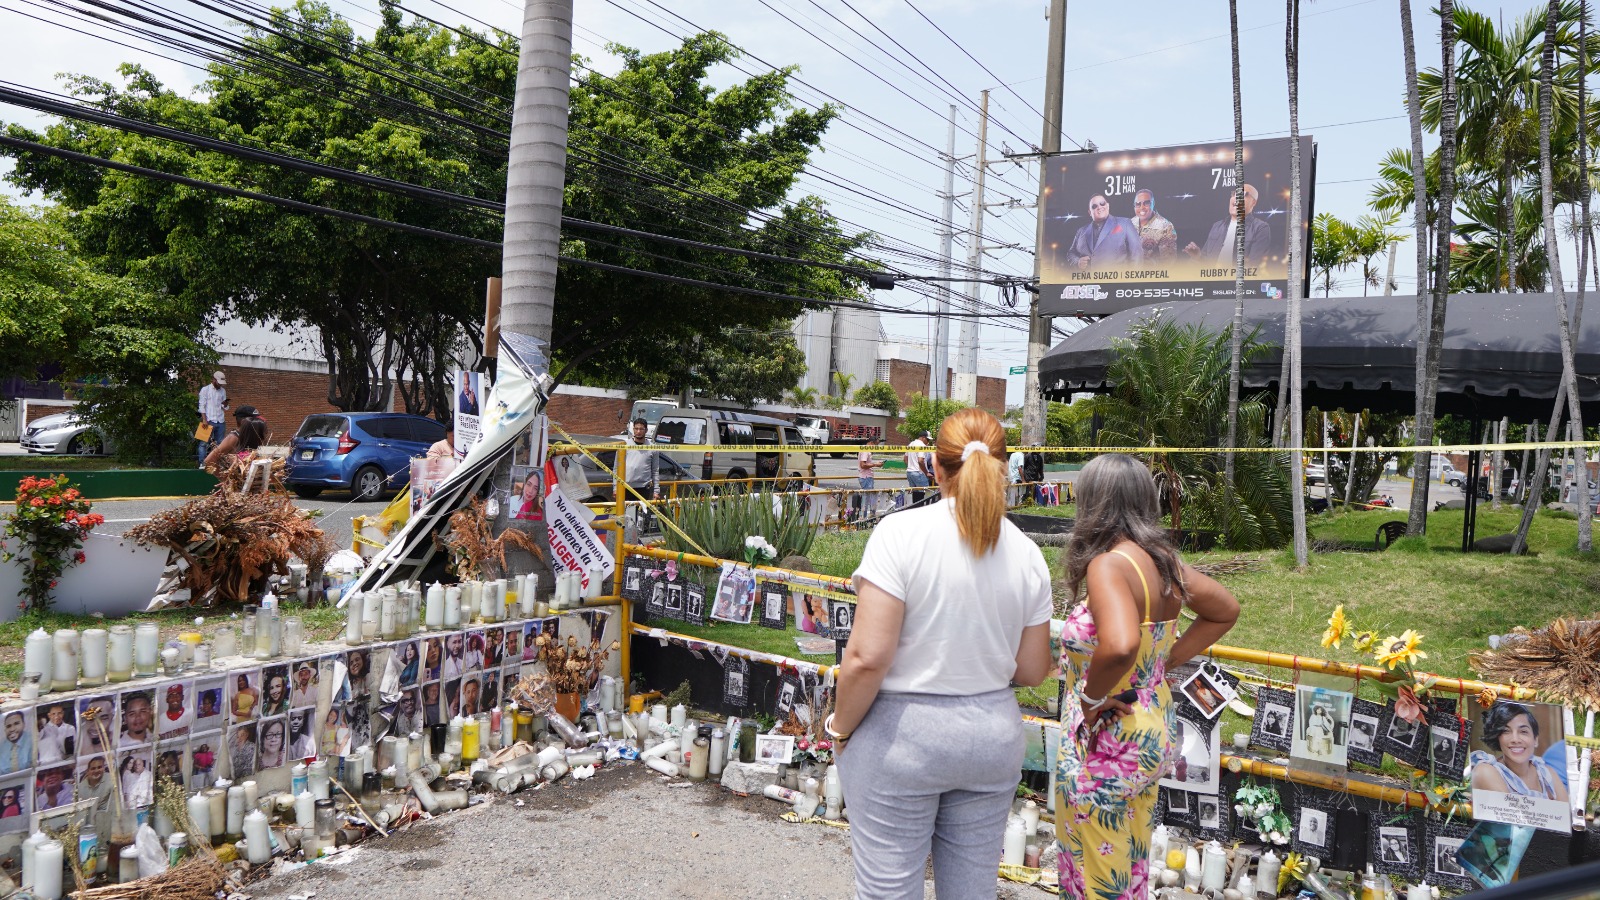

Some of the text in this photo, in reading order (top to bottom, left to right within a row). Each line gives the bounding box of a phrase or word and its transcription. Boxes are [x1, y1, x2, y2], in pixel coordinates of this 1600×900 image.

[1212, 168, 1236, 190] 7 LUN
[1222, 178, 1236, 187] ABR
[1104, 175, 1136, 196] 31 LUN
[1122, 184, 1136, 193] MAR
[1072, 270, 1169, 280] PEÑA SUAZO SEXAPPEAL
[1200, 268, 1257, 277] RUBBY PREZ
[1116, 288, 1204, 298] 809-535-4145
[554, 495, 566, 513] No
[565, 512, 604, 562] olvidaremos
[602, 561, 610, 569] a
[553, 518, 581, 554] quienes
[580, 552, 592, 566] la
